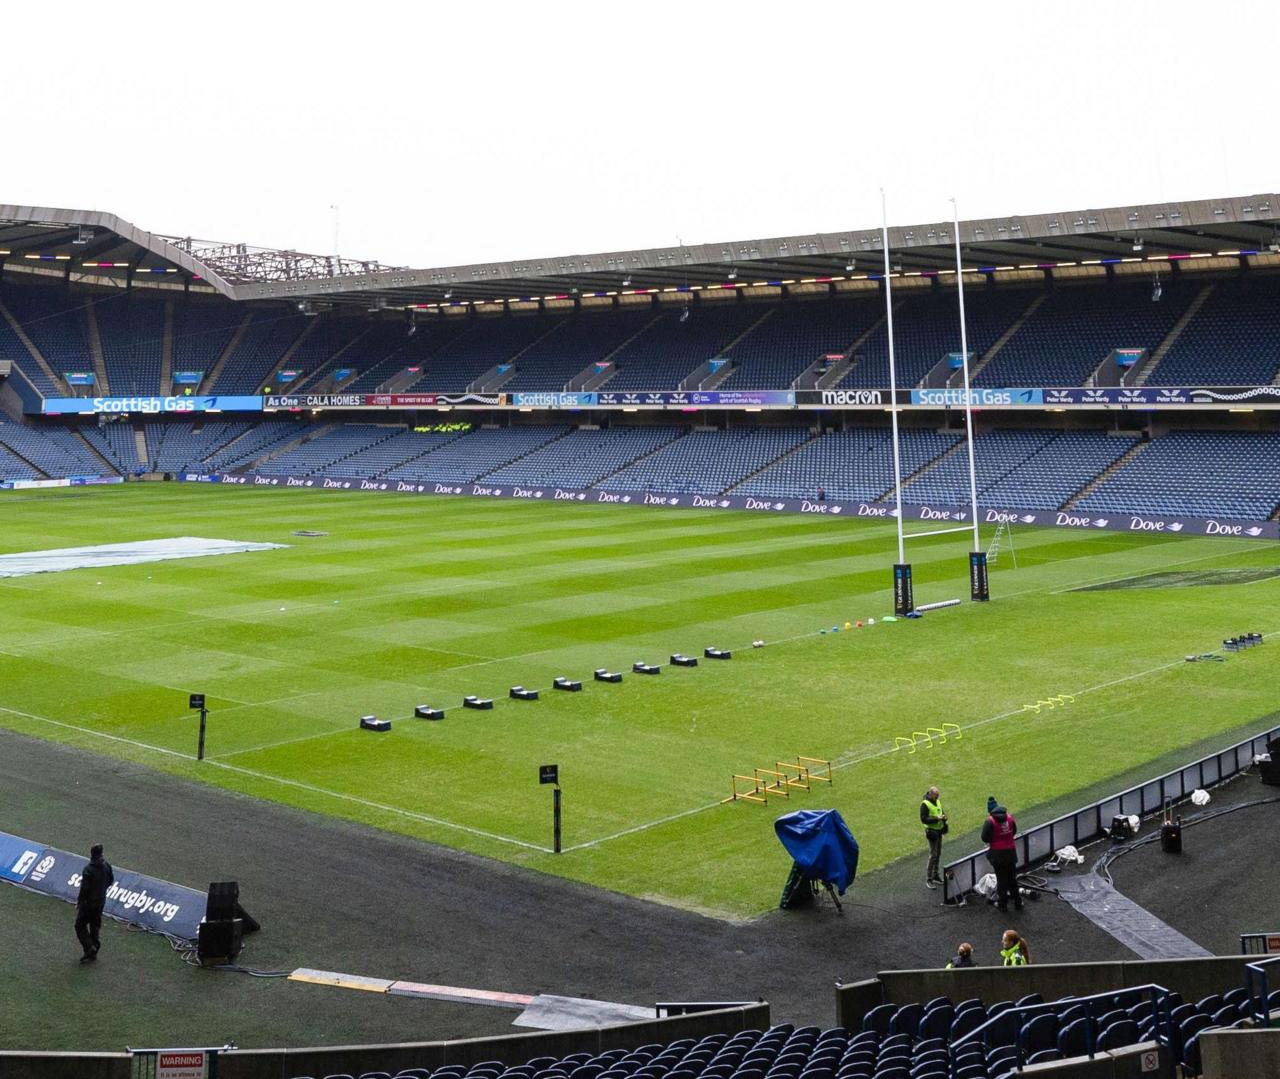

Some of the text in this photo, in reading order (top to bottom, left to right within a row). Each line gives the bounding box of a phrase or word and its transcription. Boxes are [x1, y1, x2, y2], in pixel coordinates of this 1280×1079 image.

[267, 397, 298, 406] As One
[306, 396, 360, 406] CALA HOMES
[518, 392, 578, 405] Scottish Gas
[822, 391, 881, 405] macron
[919, 389, 1011, 405] Scottish Gas
[93, 396, 194, 412] Scottish Gas
[222, 475, 238, 483] Dove
[255, 476, 271, 484] Dove
[287, 477, 304, 486] Dove
[323, 479, 341, 488] Dove
[361, 480, 379, 490] Dove
[397, 482, 415, 491] Dove
[435, 484, 453, 493] Dove
[473, 485, 492, 495] Dove
[513, 487, 532, 497] Dove
[554, 490, 575, 500] Dove
[598, 492, 619, 502] Dove
[644, 494, 666, 505] Dove
[693, 496, 716, 507] Dove
[746, 498, 770, 510] Dove
[801, 500, 827, 513] Dove
[858, 503, 885, 516] Dove
[920, 506, 950, 520] Dove
[986, 509, 1017, 523] Dove
[1056, 512, 1089, 526] Dove
[1130, 516, 1164, 531] Dove
[1206, 520, 1242, 535] Dove
[162, 1056, 202, 1066] WARNING
